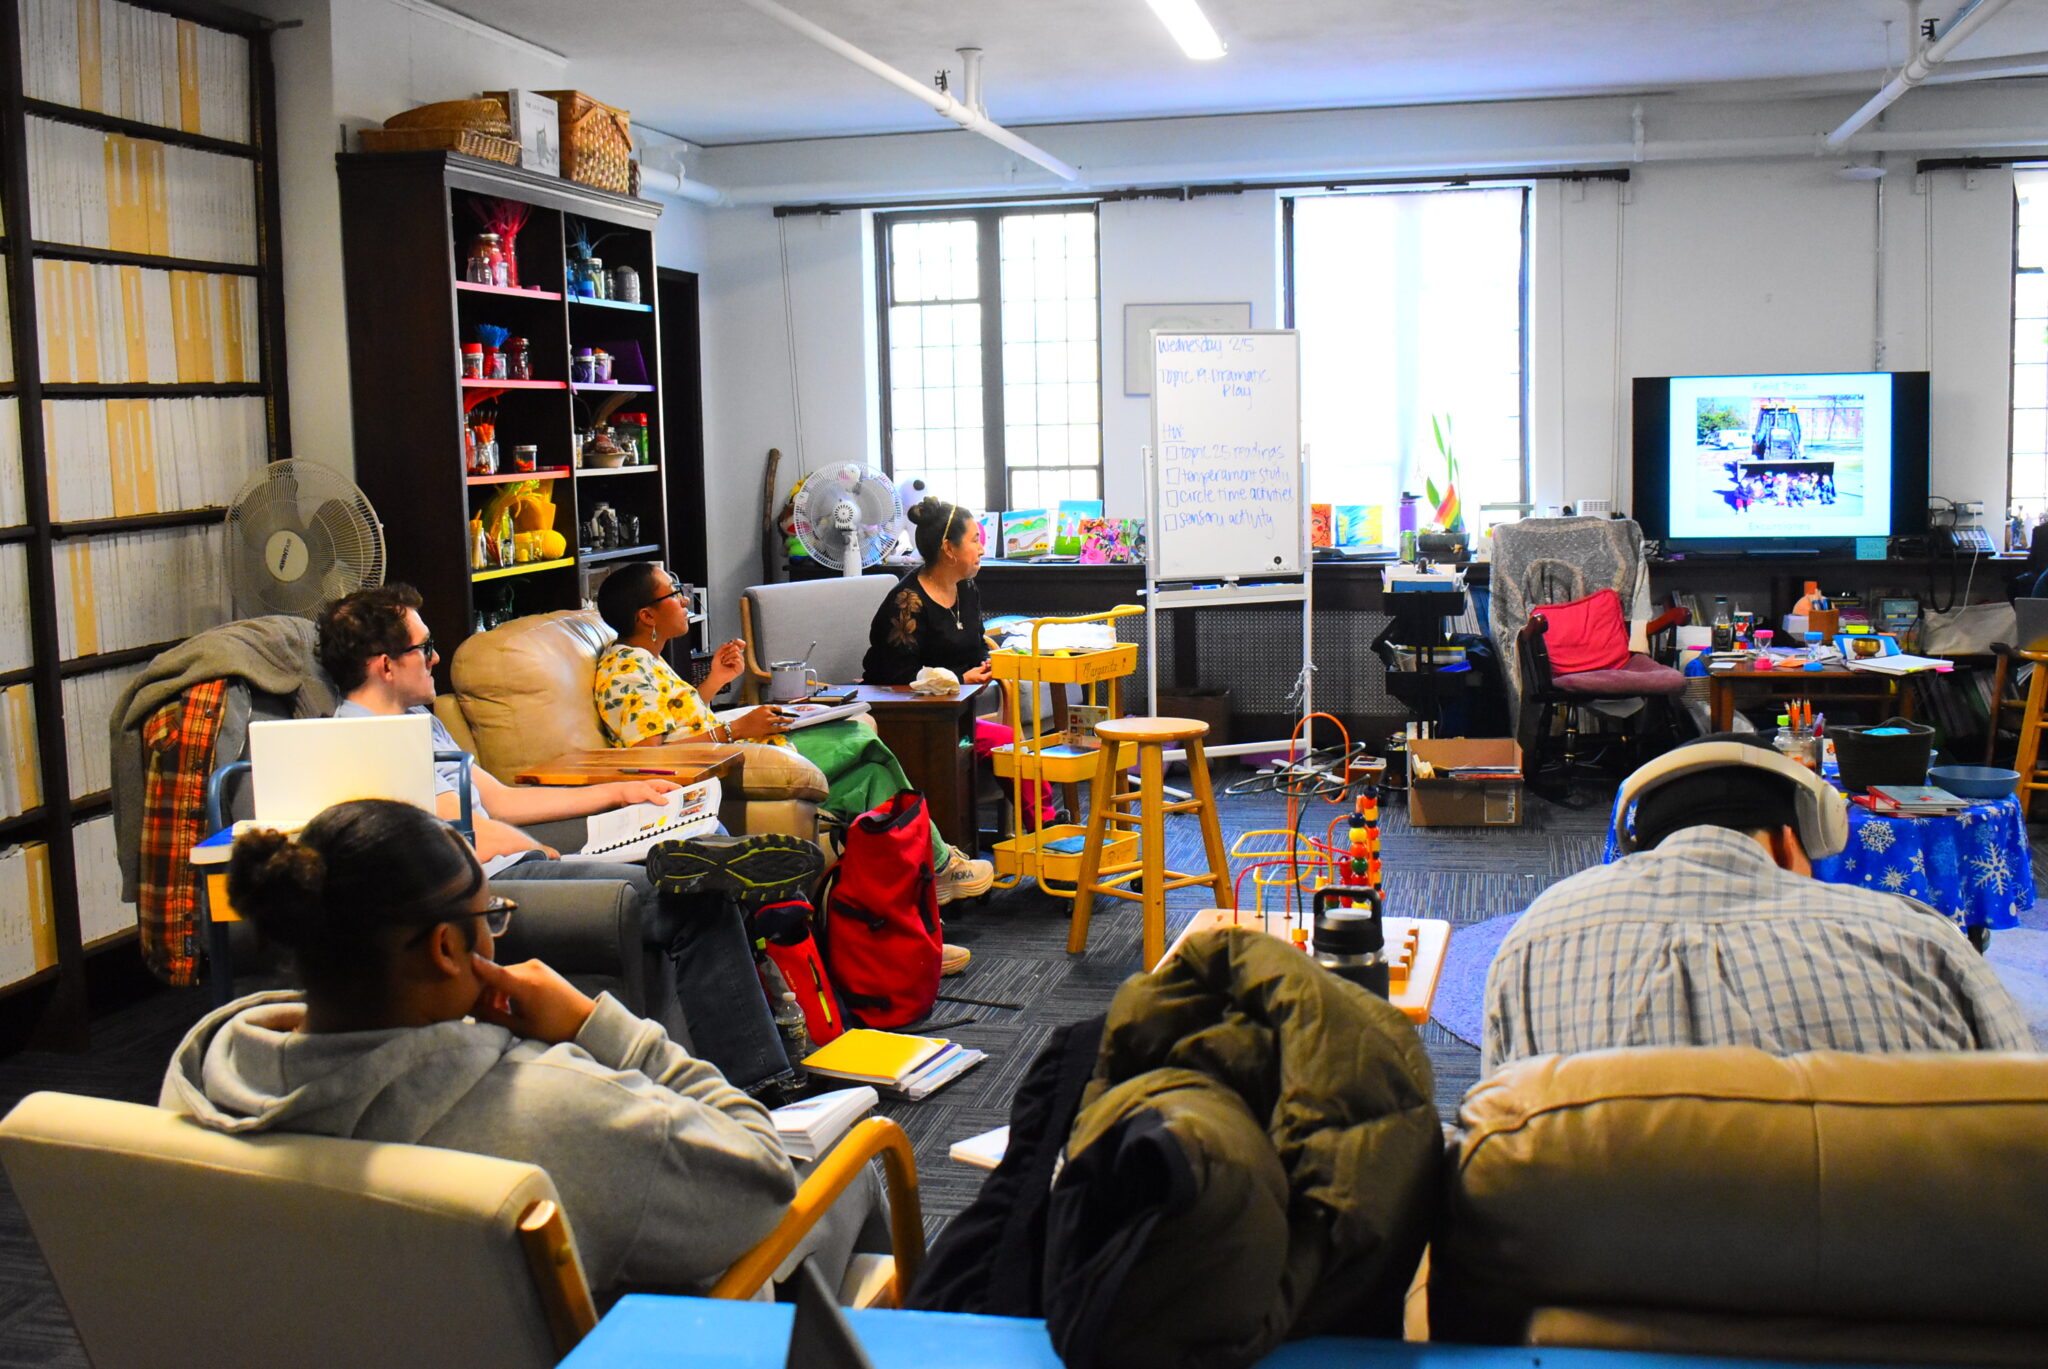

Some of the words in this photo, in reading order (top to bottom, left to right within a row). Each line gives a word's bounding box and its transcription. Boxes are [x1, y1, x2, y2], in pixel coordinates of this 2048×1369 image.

[1158, 335, 1223, 359] Wednesday
[1158, 368, 1194, 388] Topic
[1211, 367, 1271, 386] Dramatic
[1222, 382, 1252, 410] Play
[1212, 443, 1231, 460] 25
[1233, 441, 1286, 464] readings
[1179, 488, 1216, 505] circle
[1218, 487, 1248, 503] time
[1229, 506, 1275, 539] activity
[949, 869, 975, 882] HOKA
